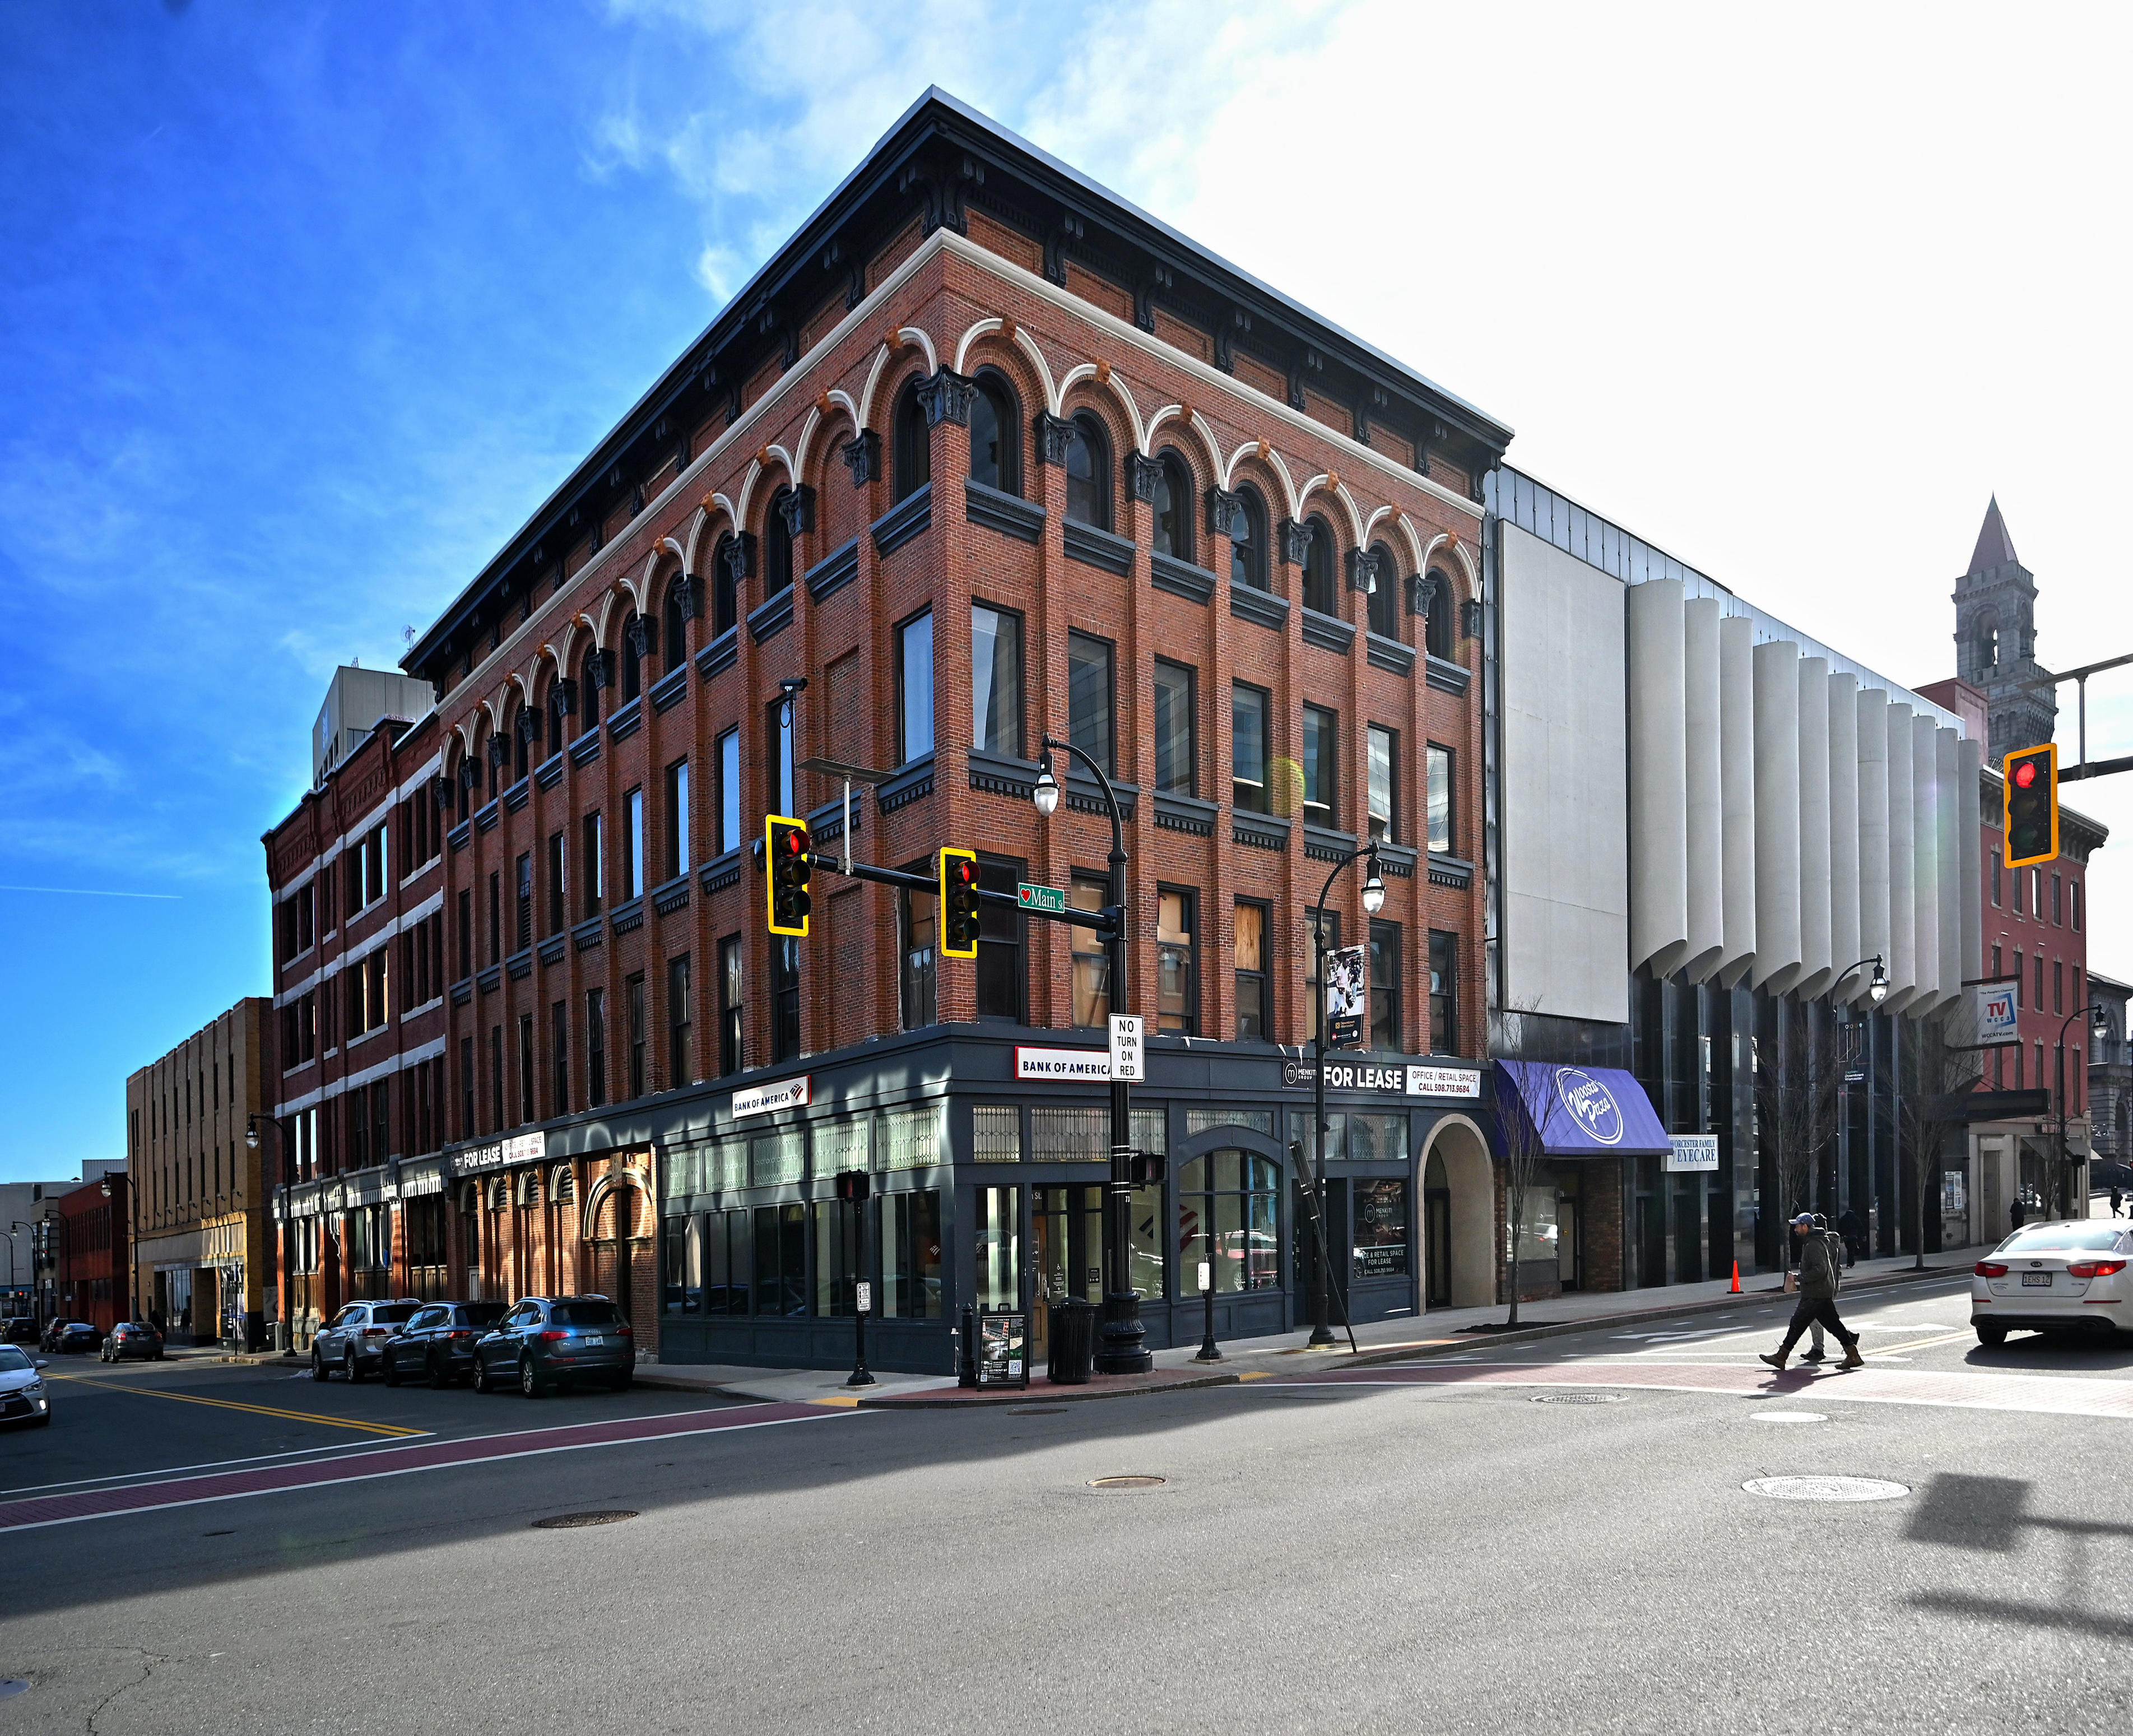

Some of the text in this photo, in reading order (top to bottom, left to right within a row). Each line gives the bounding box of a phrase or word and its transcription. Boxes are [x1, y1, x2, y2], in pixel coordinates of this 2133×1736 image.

[1031, 888, 1063, 909] Main St
[1987, 1001, 2006, 1016] TV
[1119, 1020, 1134, 1032] NO
[1117, 1036, 1137, 1047] TURN
[1122, 1051, 1132, 1061] ON
[1023, 1061, 1052, 1072] BANK
[1054, 1062, 1067, 1073] OF
[1121, 1066, 1135, 1076] RED
[1323, 1066, 1402, 1089] FOR LEASE
[1412, 1071, 1433, 1080] OFFICE
[1439, 1073, 1457, 1081] RETAIL
[1459, 1074, 1476, 1082] SPACE
[1419, 1083, 1470, 1093] CALL 508.713.9684
[735, 1092, 789, 1111] BANK OF AMERICA
[1582, 1099, 1611, 1130] Pizza
[464, 1152, 478, 1168] FOR
[478, 1146, 501, 1166] LEASE
[1677, 1149, 1716, 1162] EYECARE
